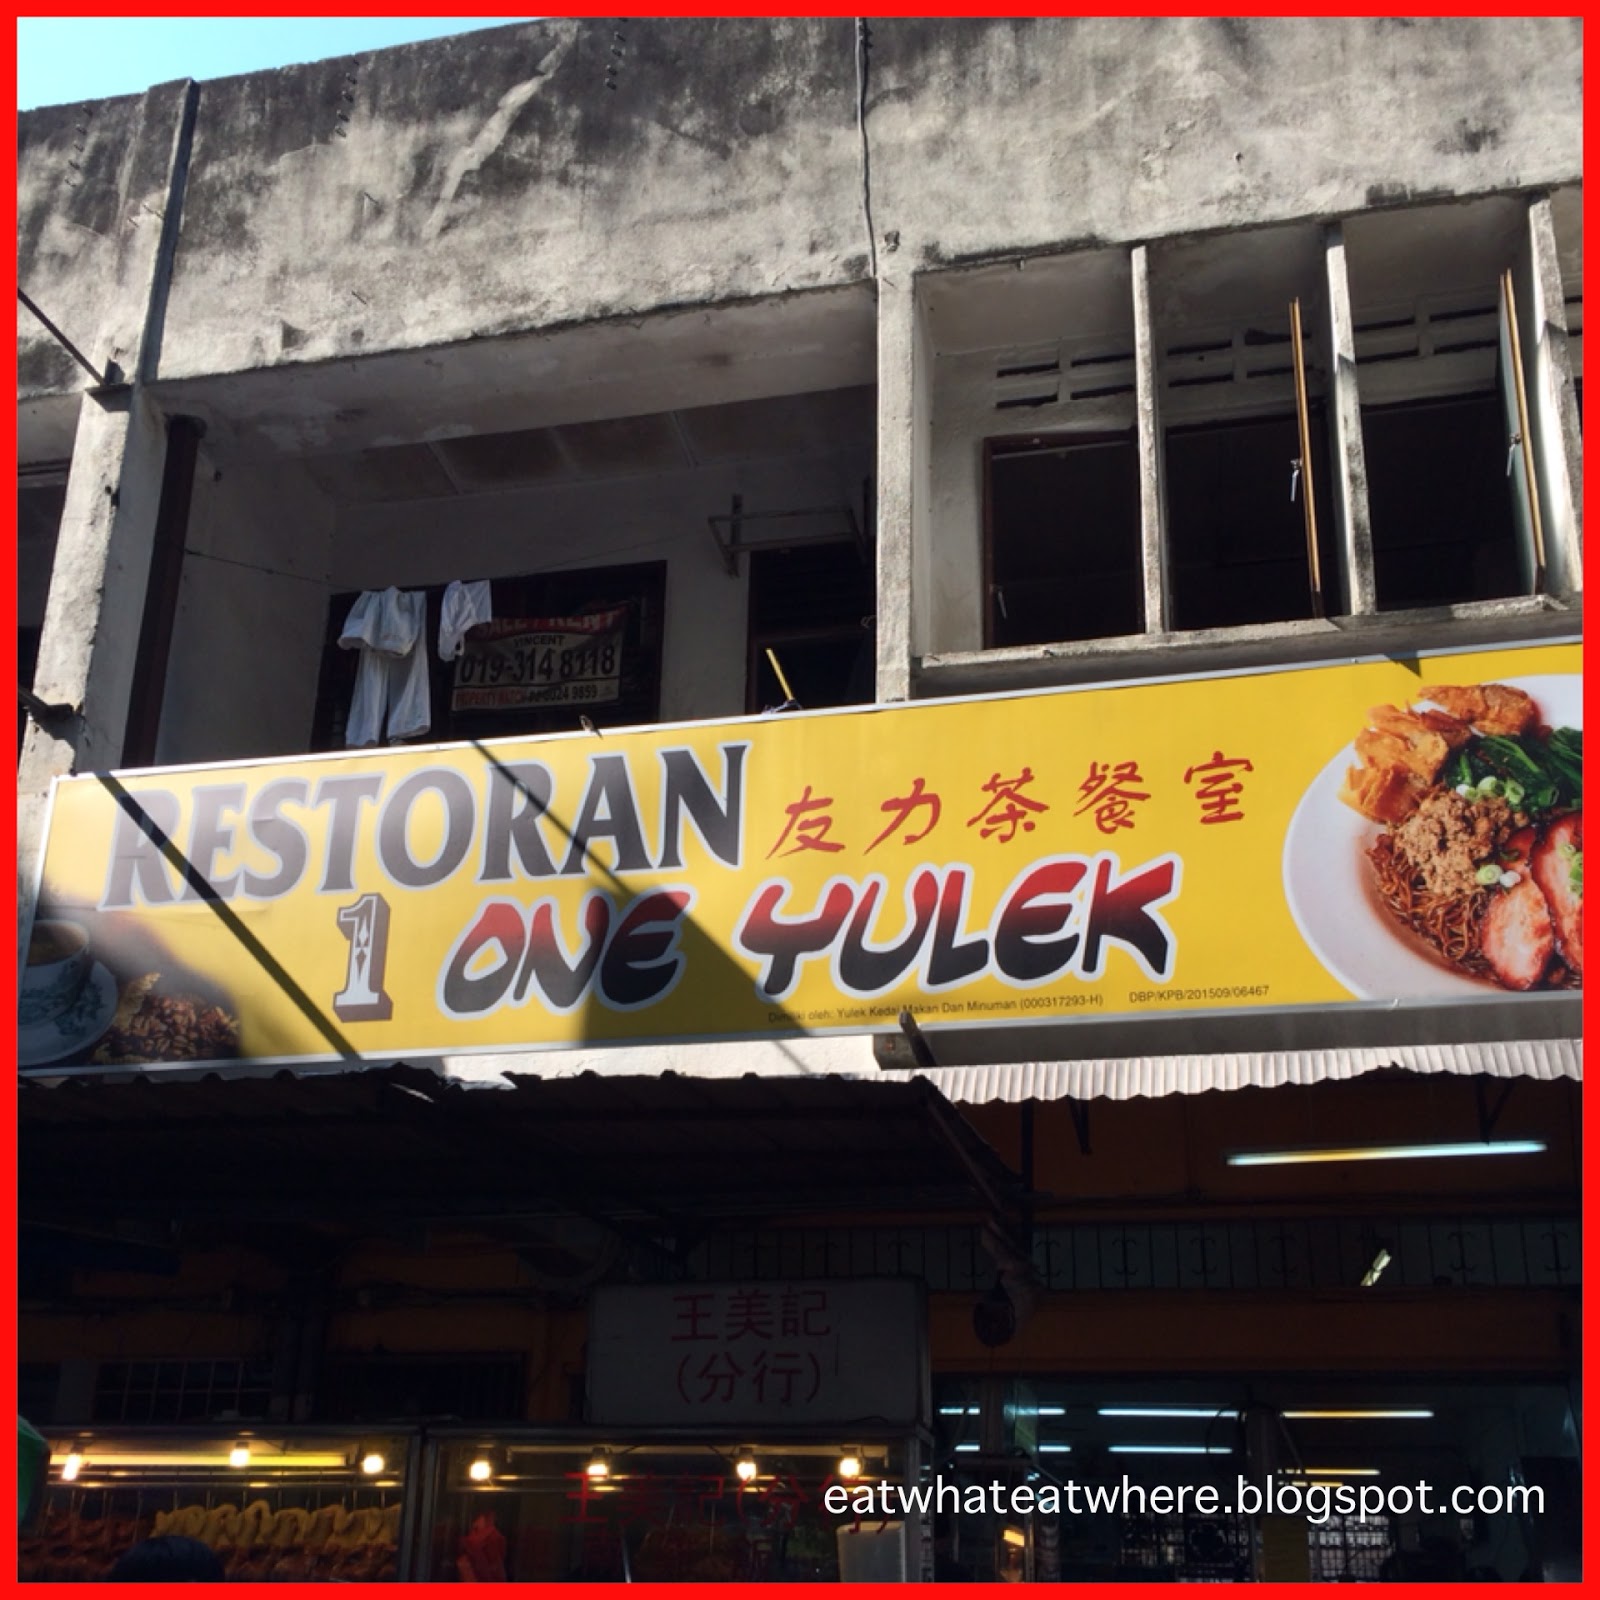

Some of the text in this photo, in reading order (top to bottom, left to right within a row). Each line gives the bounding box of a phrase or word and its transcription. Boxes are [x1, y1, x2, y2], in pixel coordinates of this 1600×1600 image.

[459, 644, 616, 684] 019-314 8118
[513, 634, 565, 648] VINCENT
[100, 740, 752, 912] RESTORAN
[765, 751, 1254, 860] 友力茶餐室
[332, 851, 1184, 1022] 1 ONE YULEK
[808, 1009, 831, 1020] oleh:
[836, 1007, 865, 1018] Yulek
[869, 1005, 899, 1017] Kedai
[902, 1003, 939, 1014] Makan
[941, 1002, 964, 1013] Dan
[967, 1000, 1017, 1011] Minuman
[671, 1289, 831, 1342] 王美記
[676, 1350, 821, 1403] (分行)
